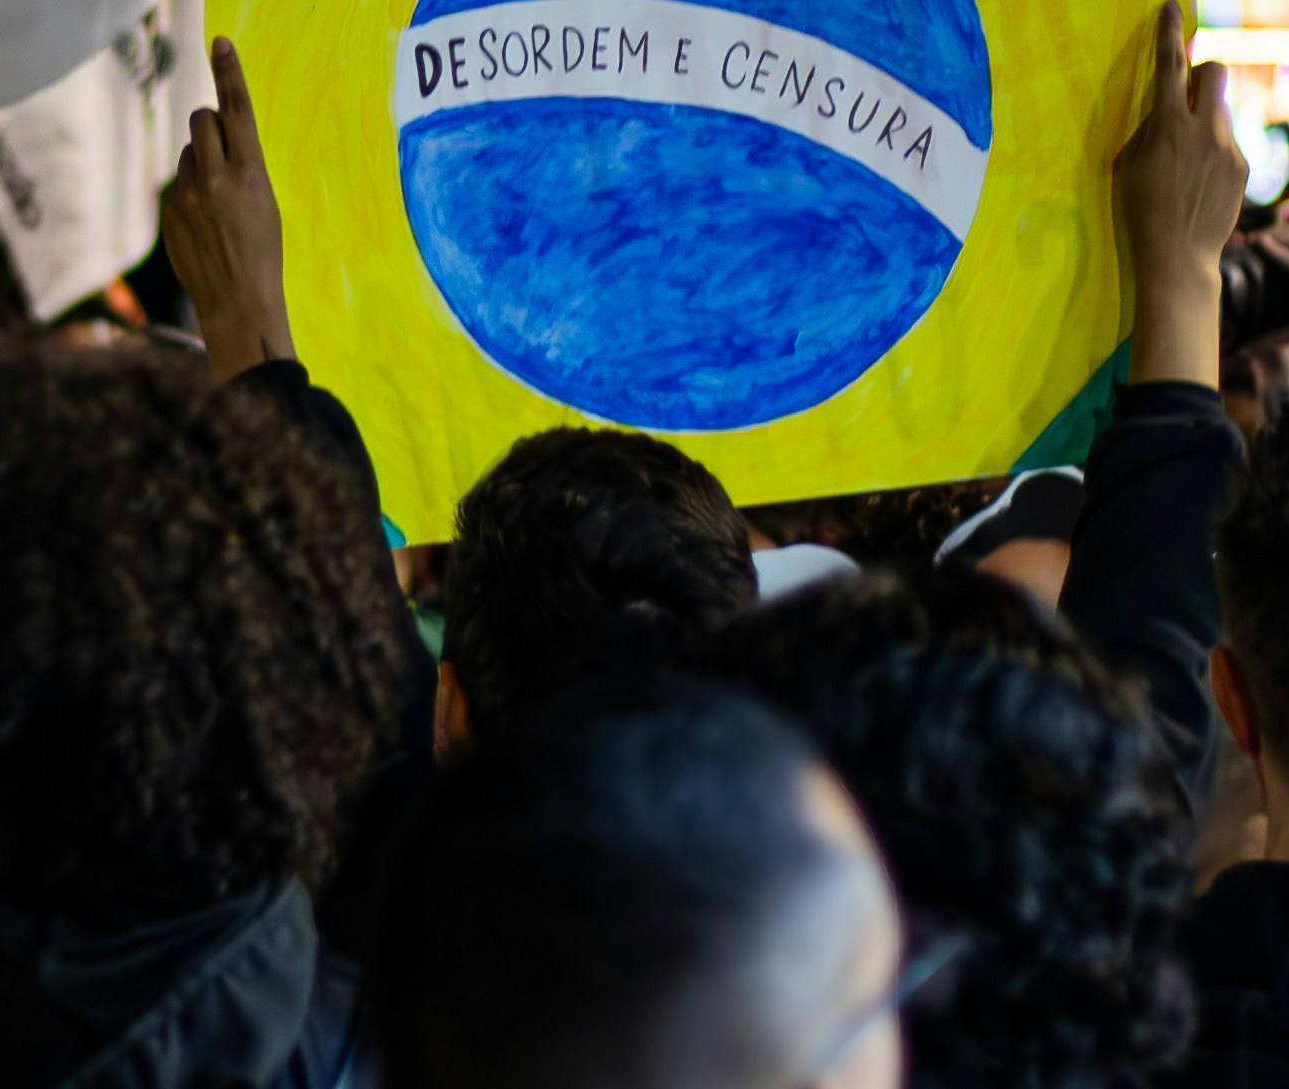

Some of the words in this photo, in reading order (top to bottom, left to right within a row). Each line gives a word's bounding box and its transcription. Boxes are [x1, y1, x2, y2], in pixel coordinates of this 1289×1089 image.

[414, 24, 649, 98] DESORDEM
[673, 37, 694, 76] E
[720, 40, 934, 172] CENSURA
